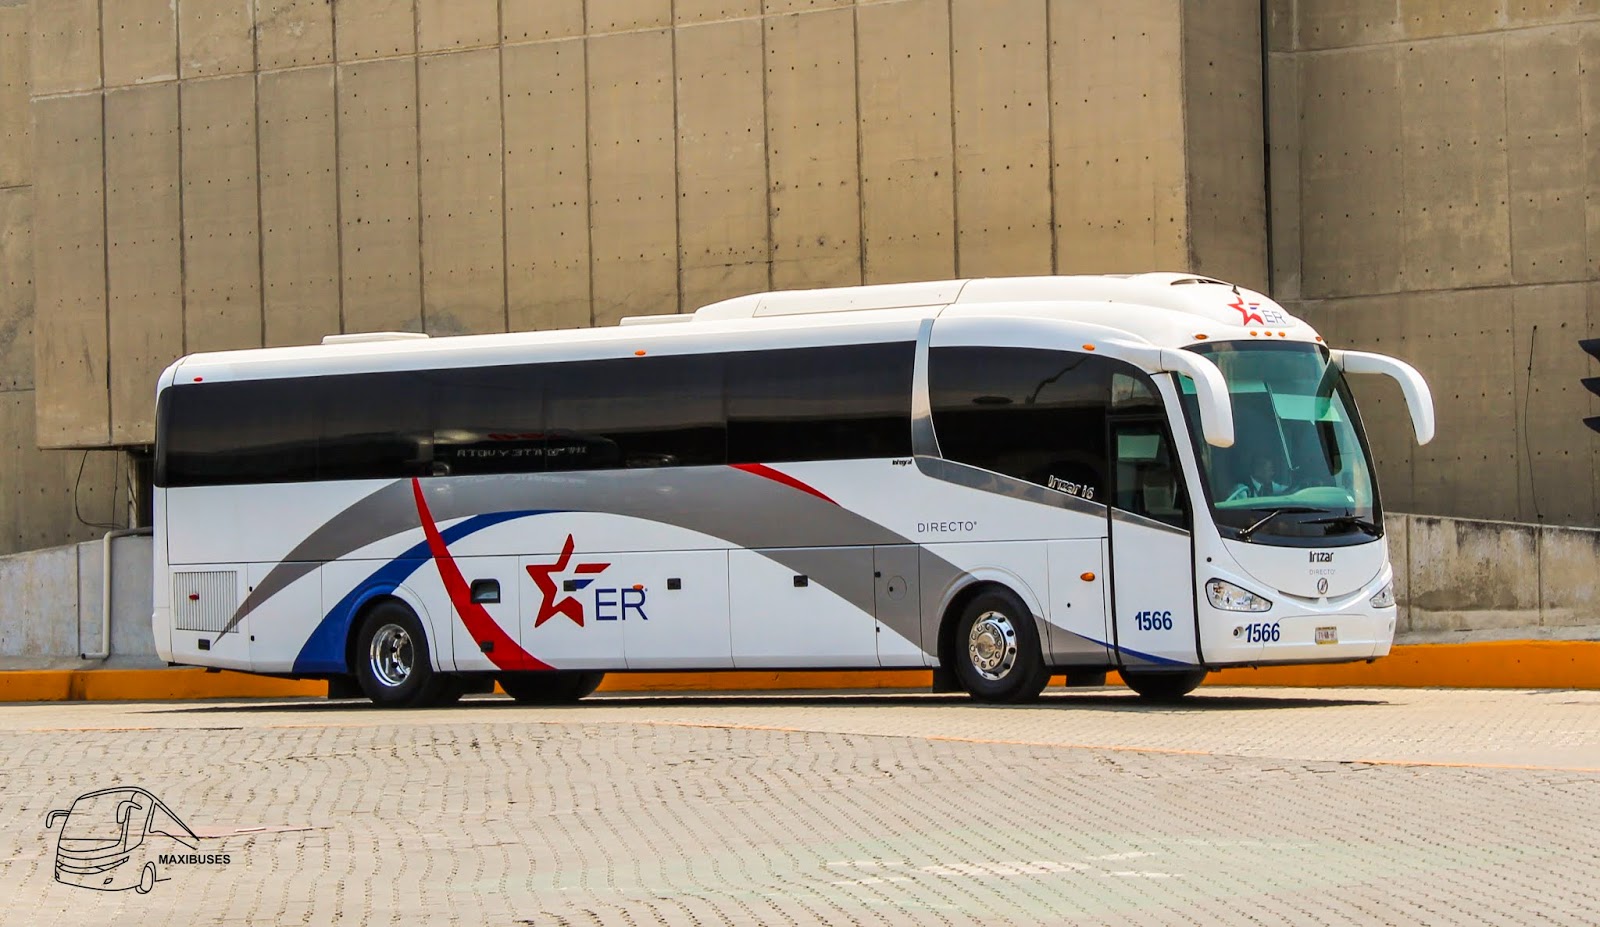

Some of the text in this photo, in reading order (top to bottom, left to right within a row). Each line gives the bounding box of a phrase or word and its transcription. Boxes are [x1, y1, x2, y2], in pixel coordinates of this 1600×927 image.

[1081, 484, 1095, 500] i6
[1309, 550, 1334, 563] Irizar
[595, 588, 648, 621] ER
[1134, 610, 1173, 631] 1566
[1244, 622, 1281, 643] 1566
